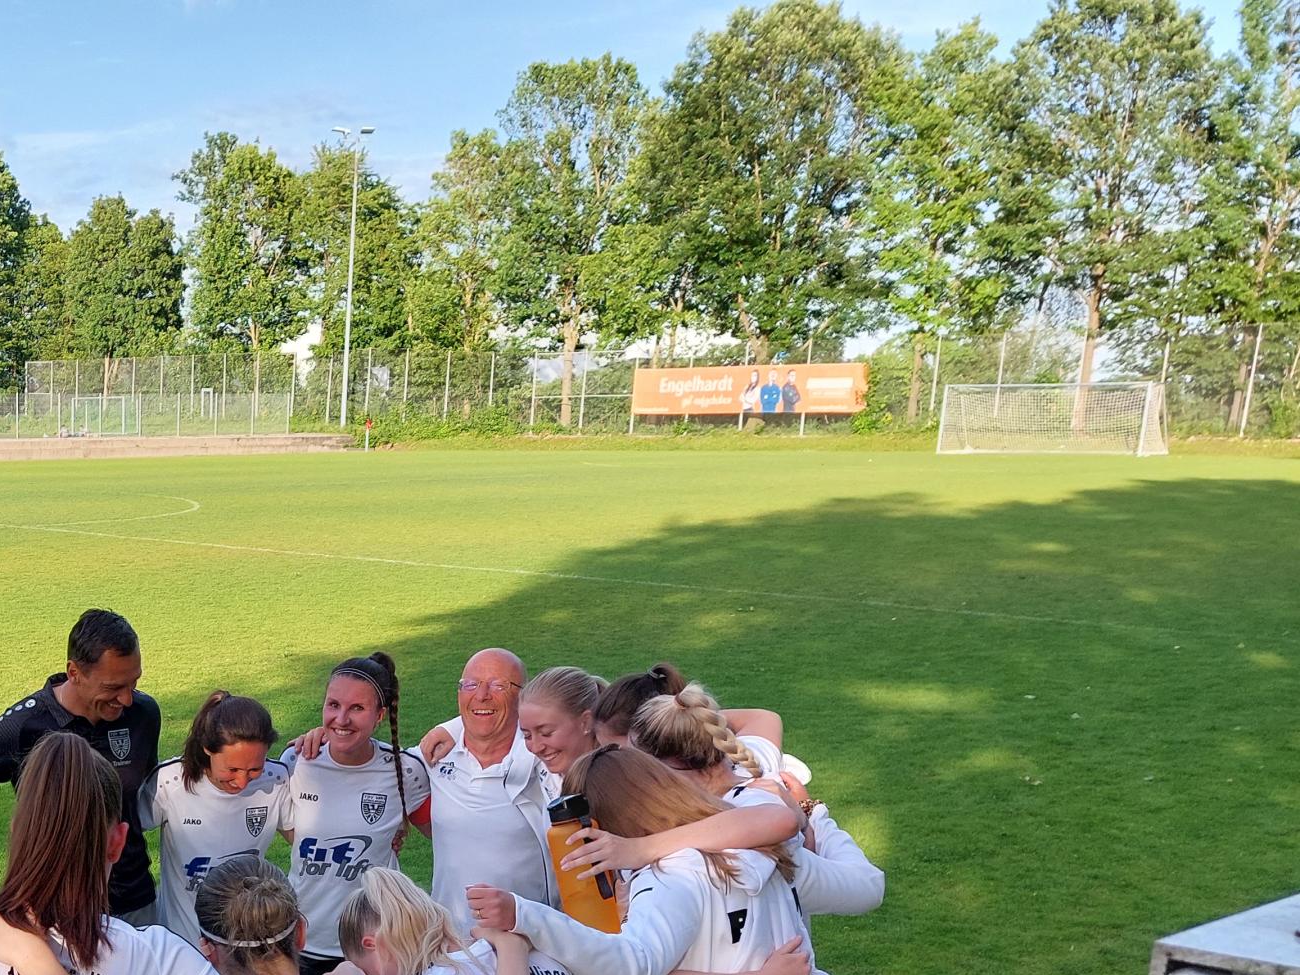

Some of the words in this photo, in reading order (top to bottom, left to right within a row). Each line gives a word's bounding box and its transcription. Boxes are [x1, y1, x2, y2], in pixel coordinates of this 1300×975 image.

[659, 376, 733, 396] Engelhardt
[299, 792, 319, 801] JAKO
[299, 838, 355, 863] fit
[300, 857, 332, 876] for
